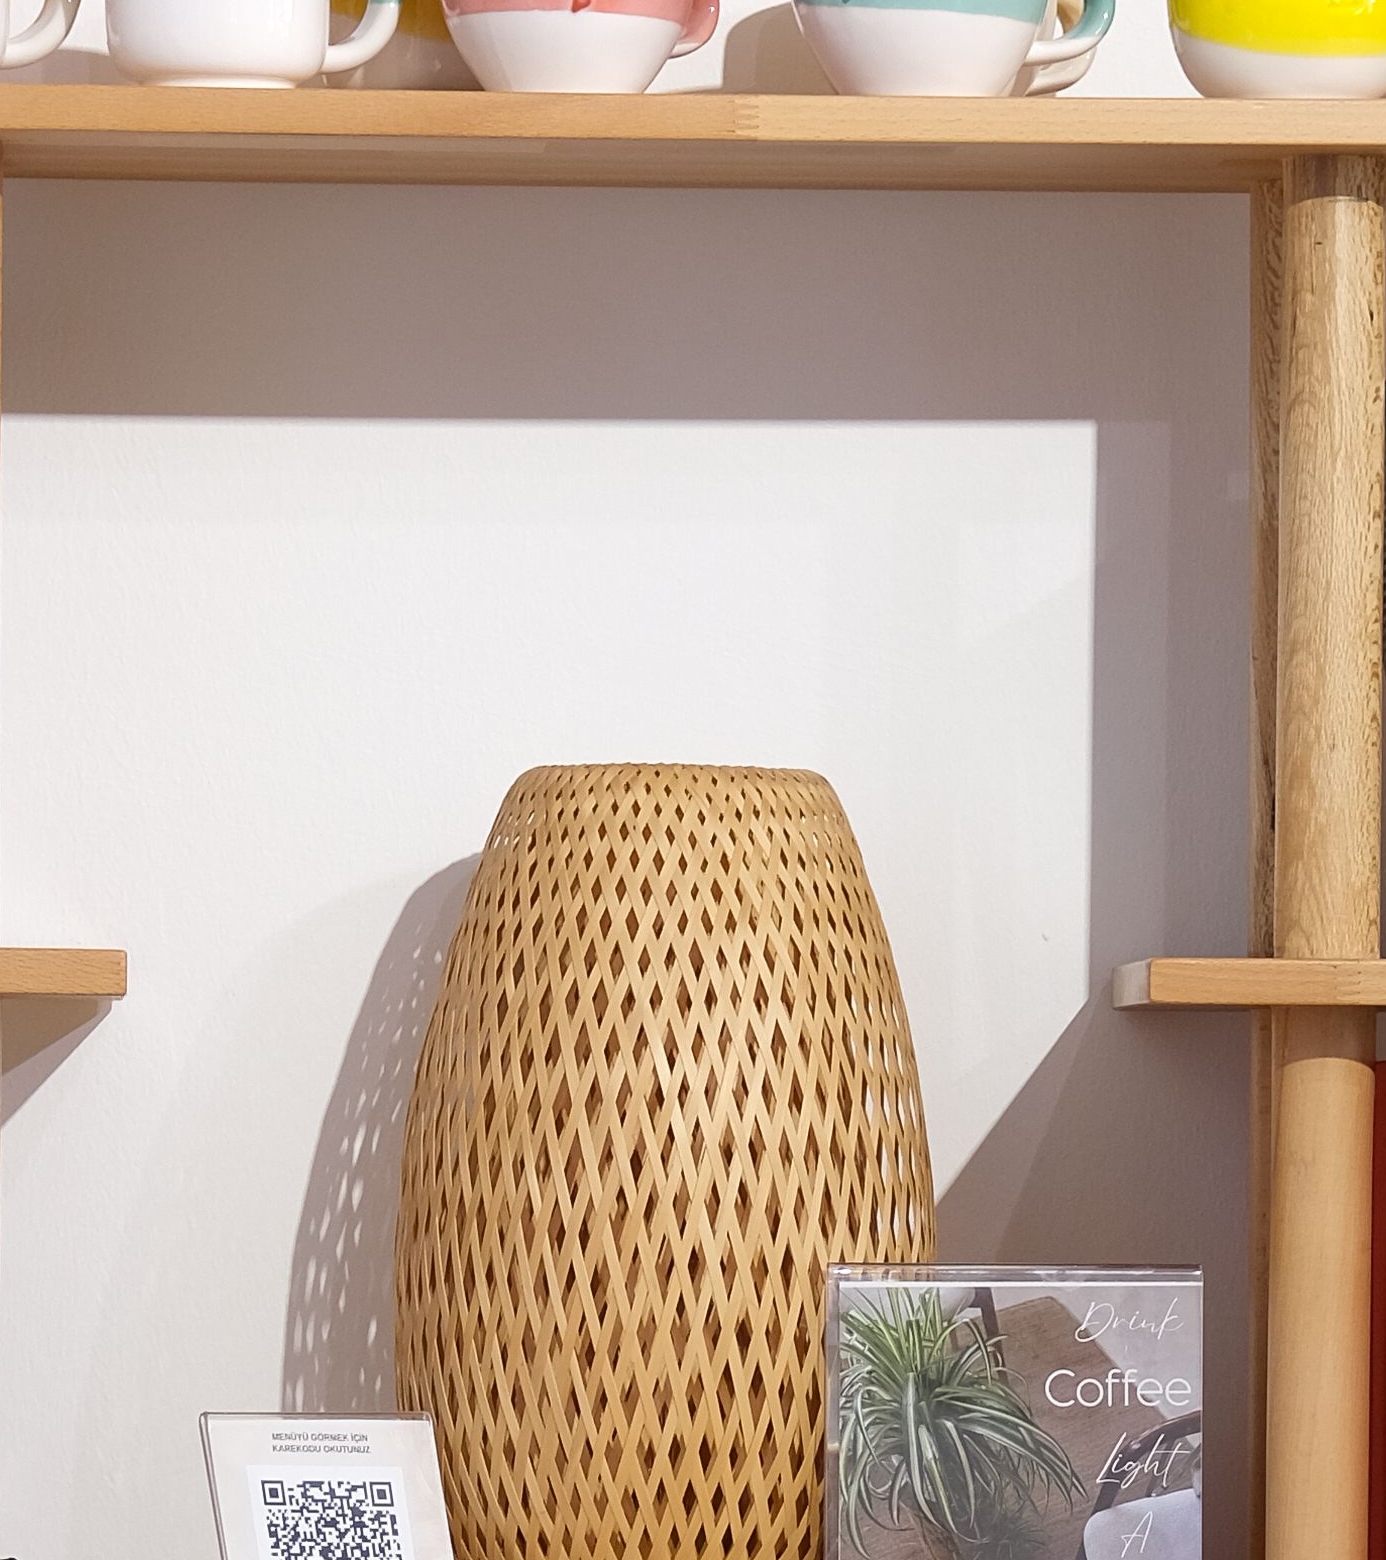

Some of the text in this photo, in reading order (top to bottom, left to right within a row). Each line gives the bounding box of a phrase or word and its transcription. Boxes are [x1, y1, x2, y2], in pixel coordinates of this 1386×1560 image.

[1075, 1297, 1184, 1344] Drink
[1044, 1368, 1192, 1408] Coffee
[1096, 1431, 1191, 1489] Light
[1120, 1511, 1153, 1558] A
